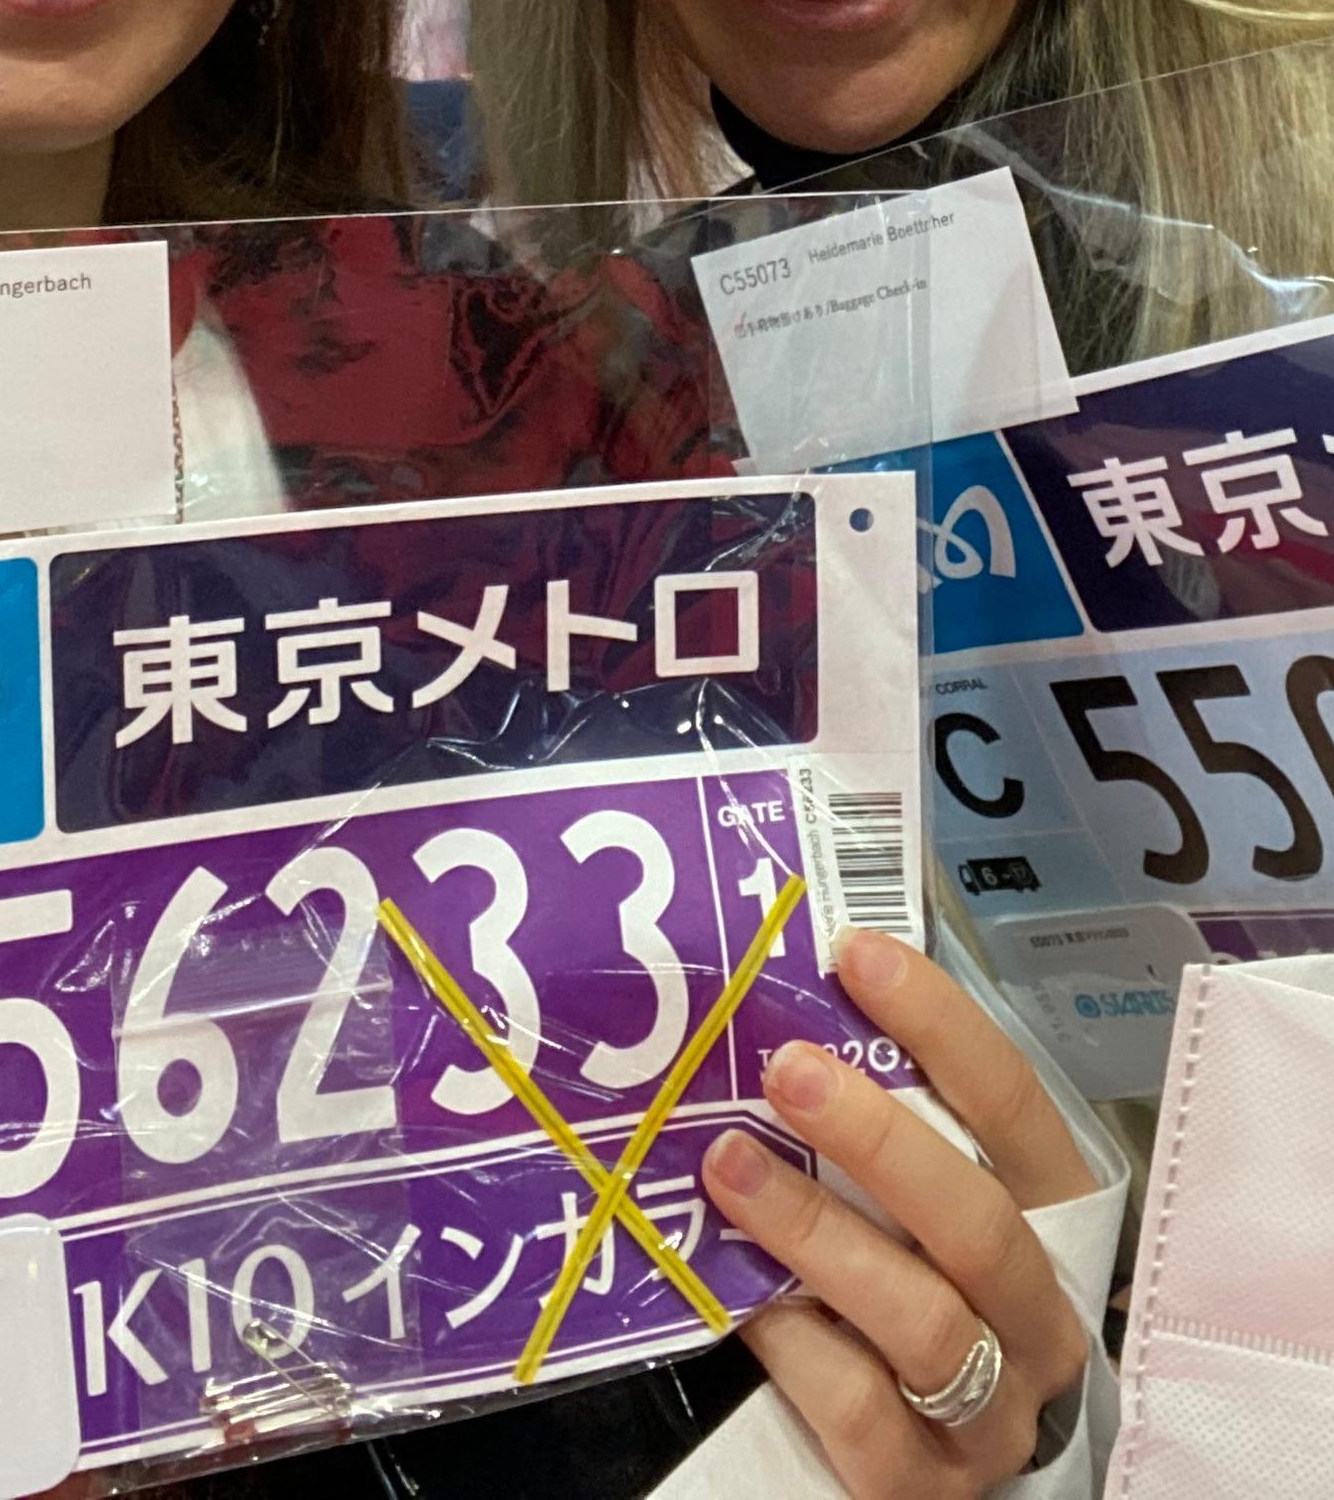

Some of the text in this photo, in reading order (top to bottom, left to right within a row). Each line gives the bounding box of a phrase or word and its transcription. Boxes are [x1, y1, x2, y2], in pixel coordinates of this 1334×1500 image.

[720, 257, 792, 296] C55073
[808, 234, 884, 264] Heidemarie
[113, 570, 760, 748] 東京メトロ
[932, 712, 1025, 819] C
[717, 800, 787, 828] GATE
